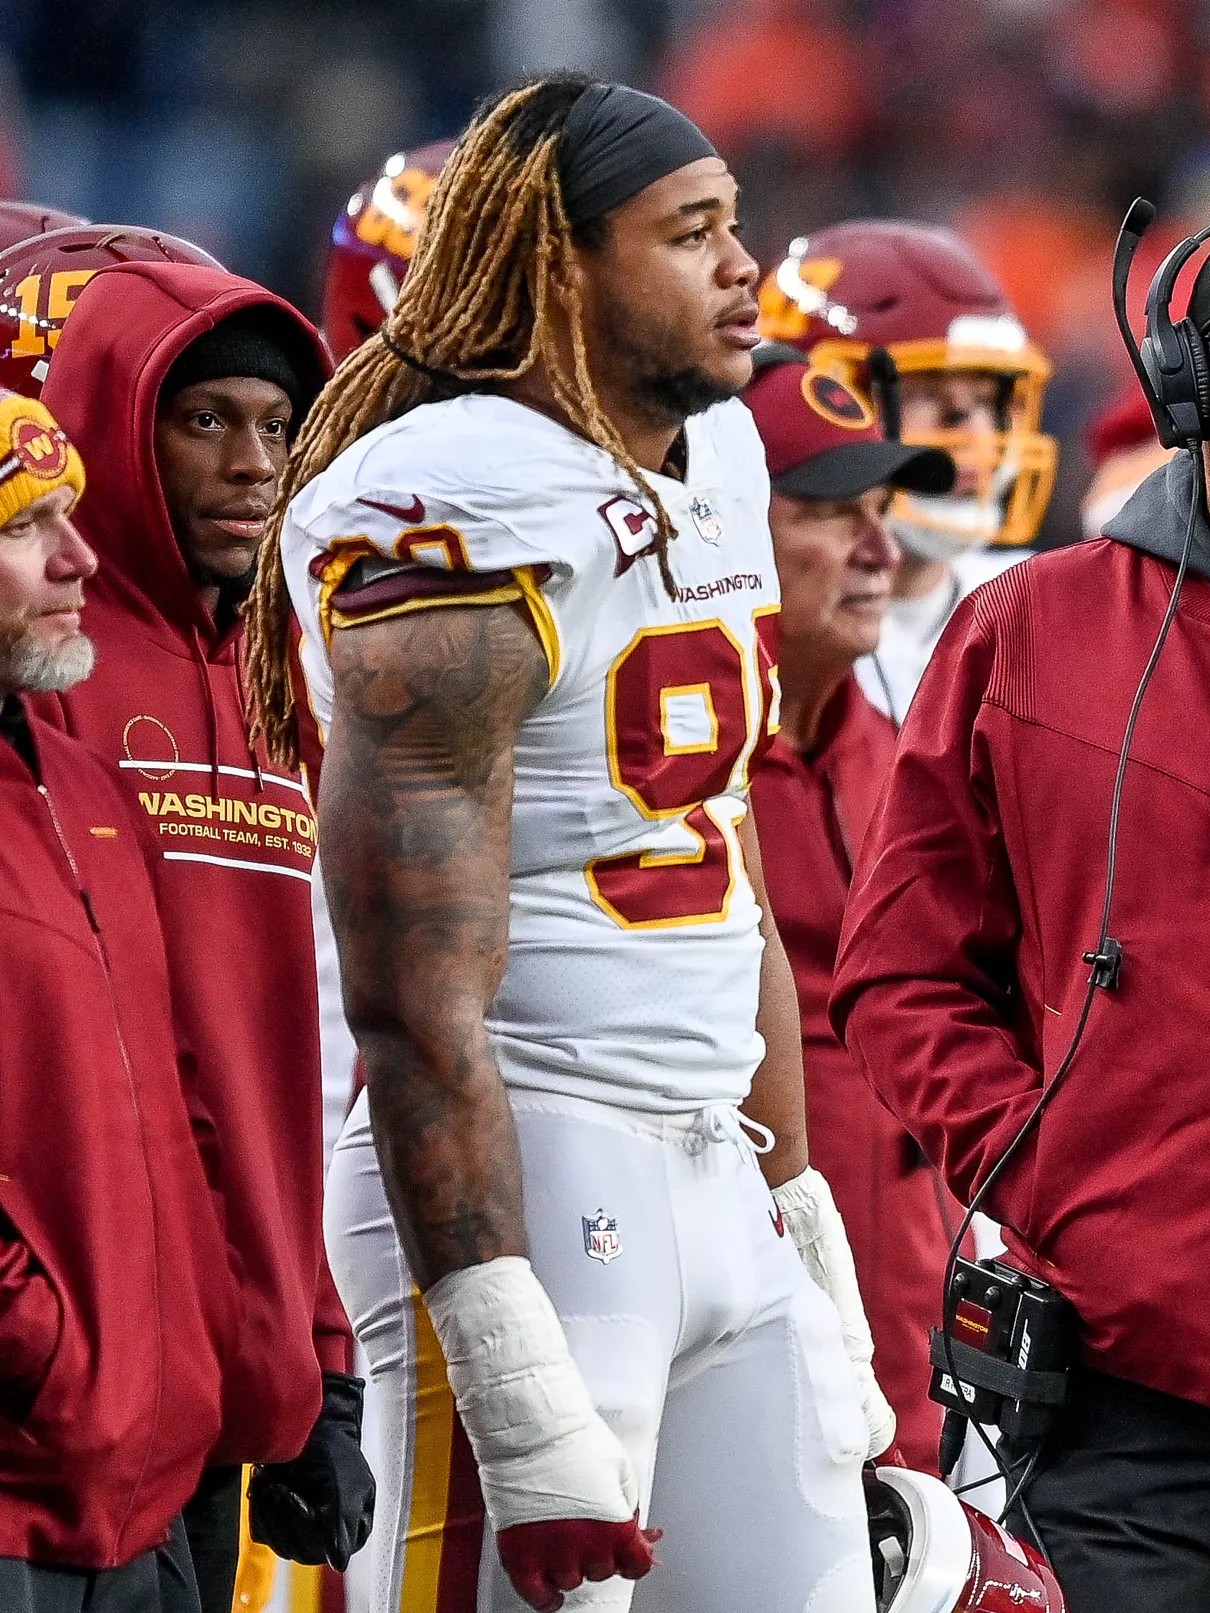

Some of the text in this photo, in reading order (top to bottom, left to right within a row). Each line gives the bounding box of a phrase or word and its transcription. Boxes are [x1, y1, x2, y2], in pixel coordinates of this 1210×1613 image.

[11, 270, 101, 358] 15
[23, 432, 54, 461] W
[605, 499, 656, 556] C
[159, 822, 312, 858] FOOTBALL TEAM, EST. 1932
[590, 1234, 618, 1253] NFL
